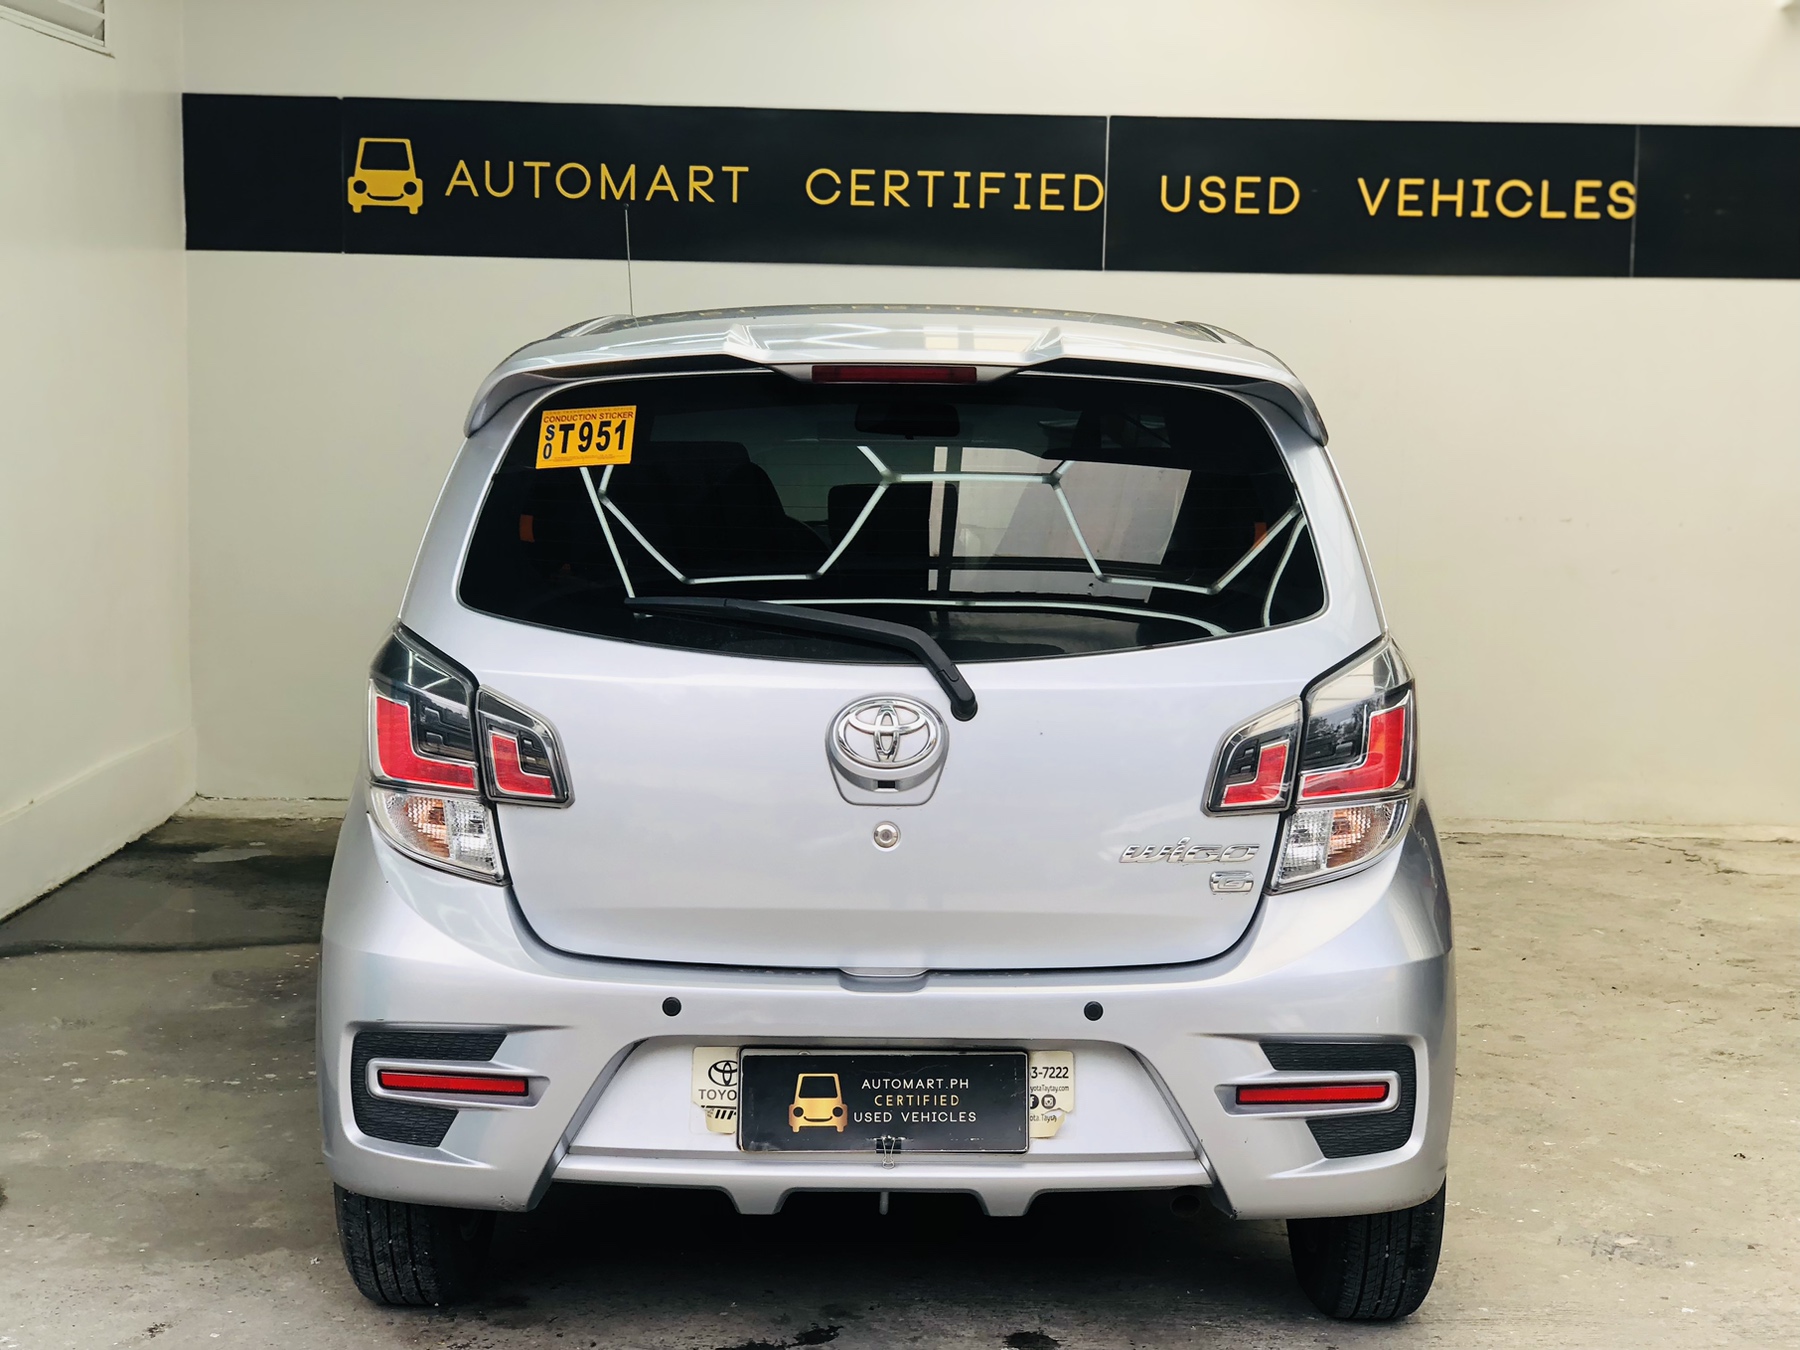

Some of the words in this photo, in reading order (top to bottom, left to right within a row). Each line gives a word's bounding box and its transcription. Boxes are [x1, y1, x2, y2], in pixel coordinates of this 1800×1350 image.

[445, 159, 750, 205] AUTOMART
[805, 167, 1106, 213] CERTIFIED
[1160, 174, 1301, 216] USED
[1357, 177, 1638, 221] VEHICLES
[543, 413, 597, 424] CONDUCTION
[598, 411, 634, 421] STICKER
[559, 419, 627, 454] T951
[861, 1078, 969, 1090] AUTOMART.PH
[874, 1094, 960, 1107] CERTIFIED
[853, 1111, 893, 1123] USED
[900, 1111, 977, 1123] VEHICLES
